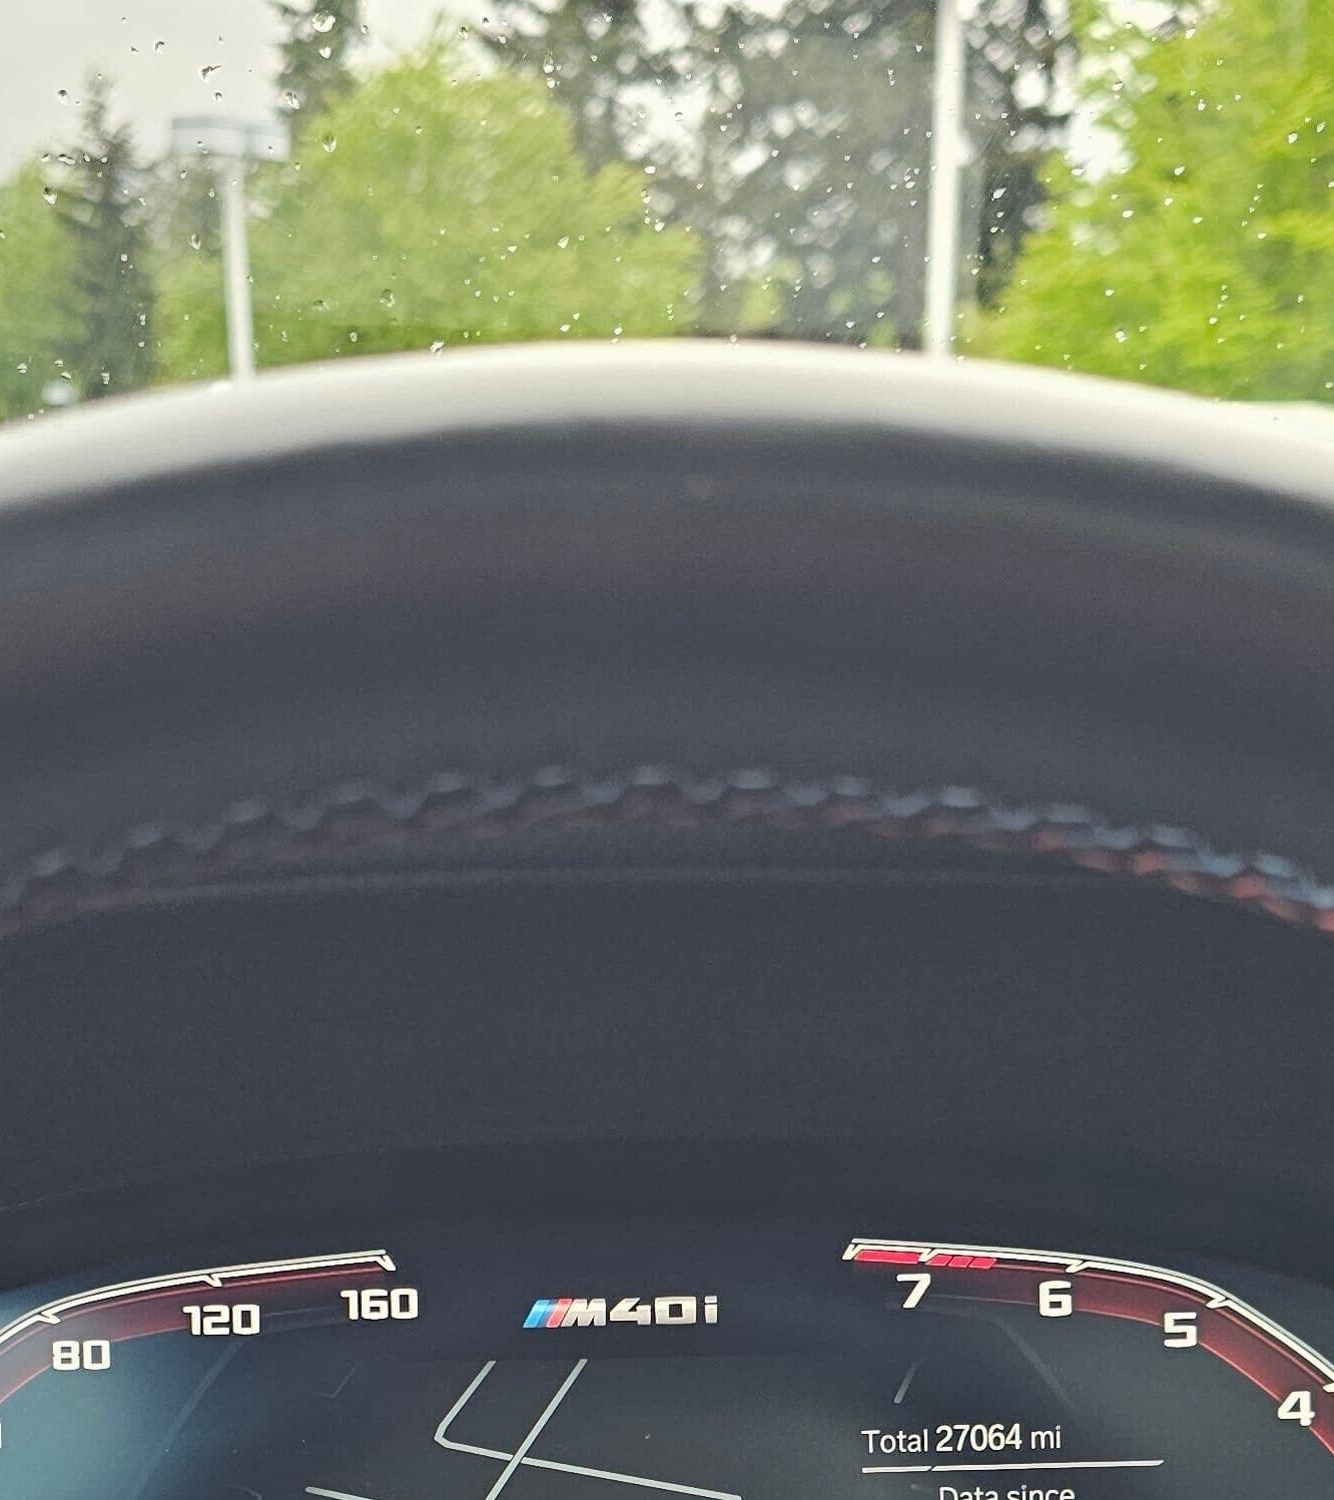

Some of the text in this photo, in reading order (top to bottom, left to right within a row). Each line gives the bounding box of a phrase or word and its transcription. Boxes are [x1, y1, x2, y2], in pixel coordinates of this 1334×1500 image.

[340, 1287, 418, 1321] 160
[896, 1273, 931, 1308] 7
[1038, 1280, 1073, 1317] 6
[182, 1303, 261, 1337] 120
[1163, 1311, 1198, 1348] 5
[51, 1339, 112, 1371] 80
[1277, 1390, 1315, 1426] 4
[861, 1423, 1061, 1454] Total 27064 mi
